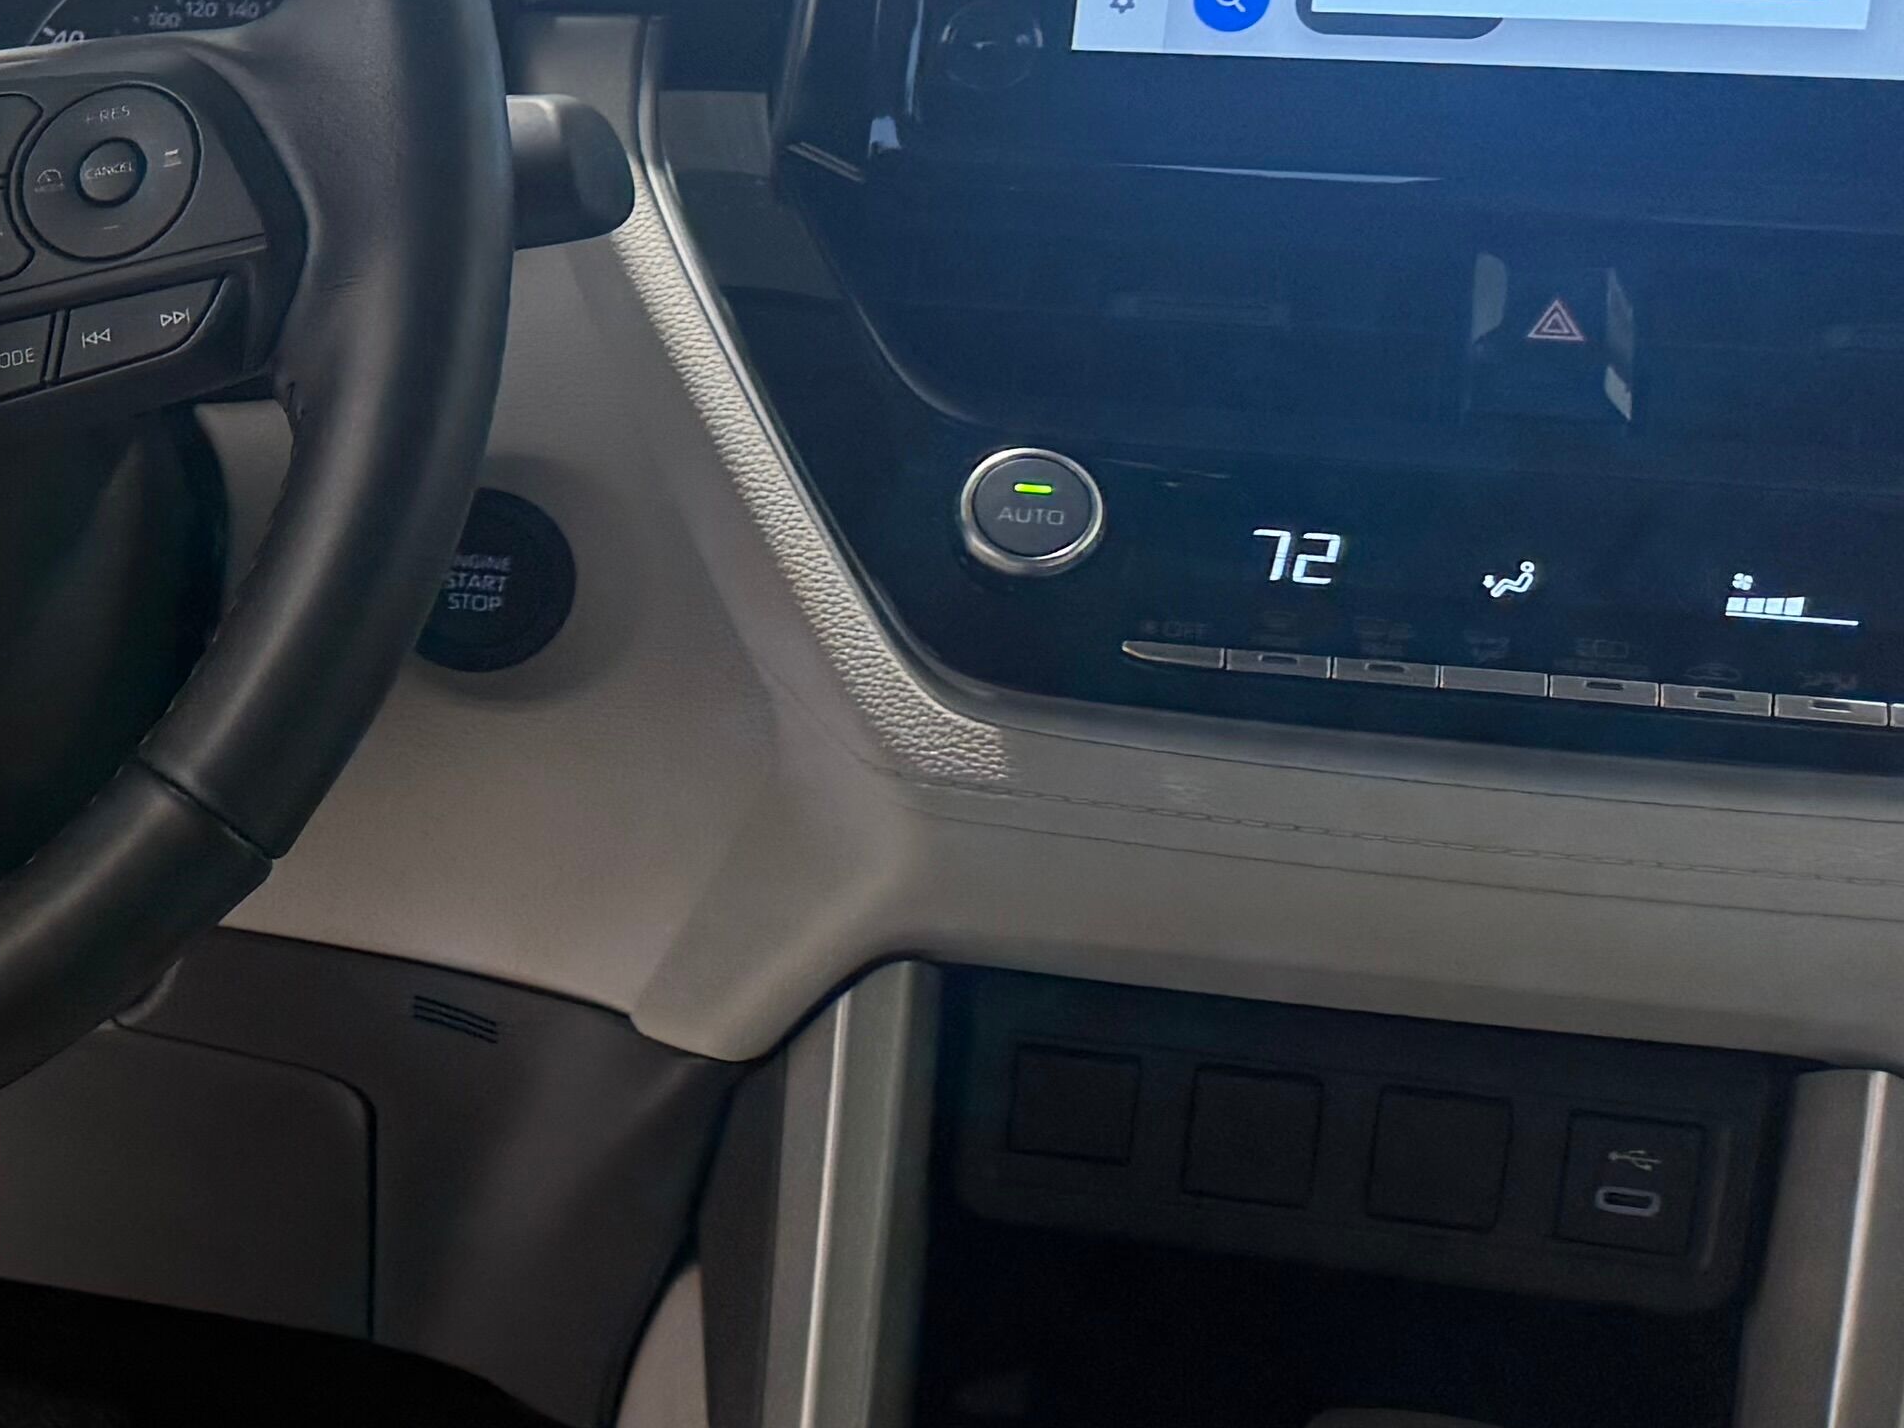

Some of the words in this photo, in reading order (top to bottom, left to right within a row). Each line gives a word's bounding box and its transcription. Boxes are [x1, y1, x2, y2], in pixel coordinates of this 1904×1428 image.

[996, 504, 1066, 529] AUTO
[452, 553, 513, 572] NGINE
[1252, 526, 1343, 587] 72
[445, 573, 509, 593] START
[448, 594, 502, 611] STOP
